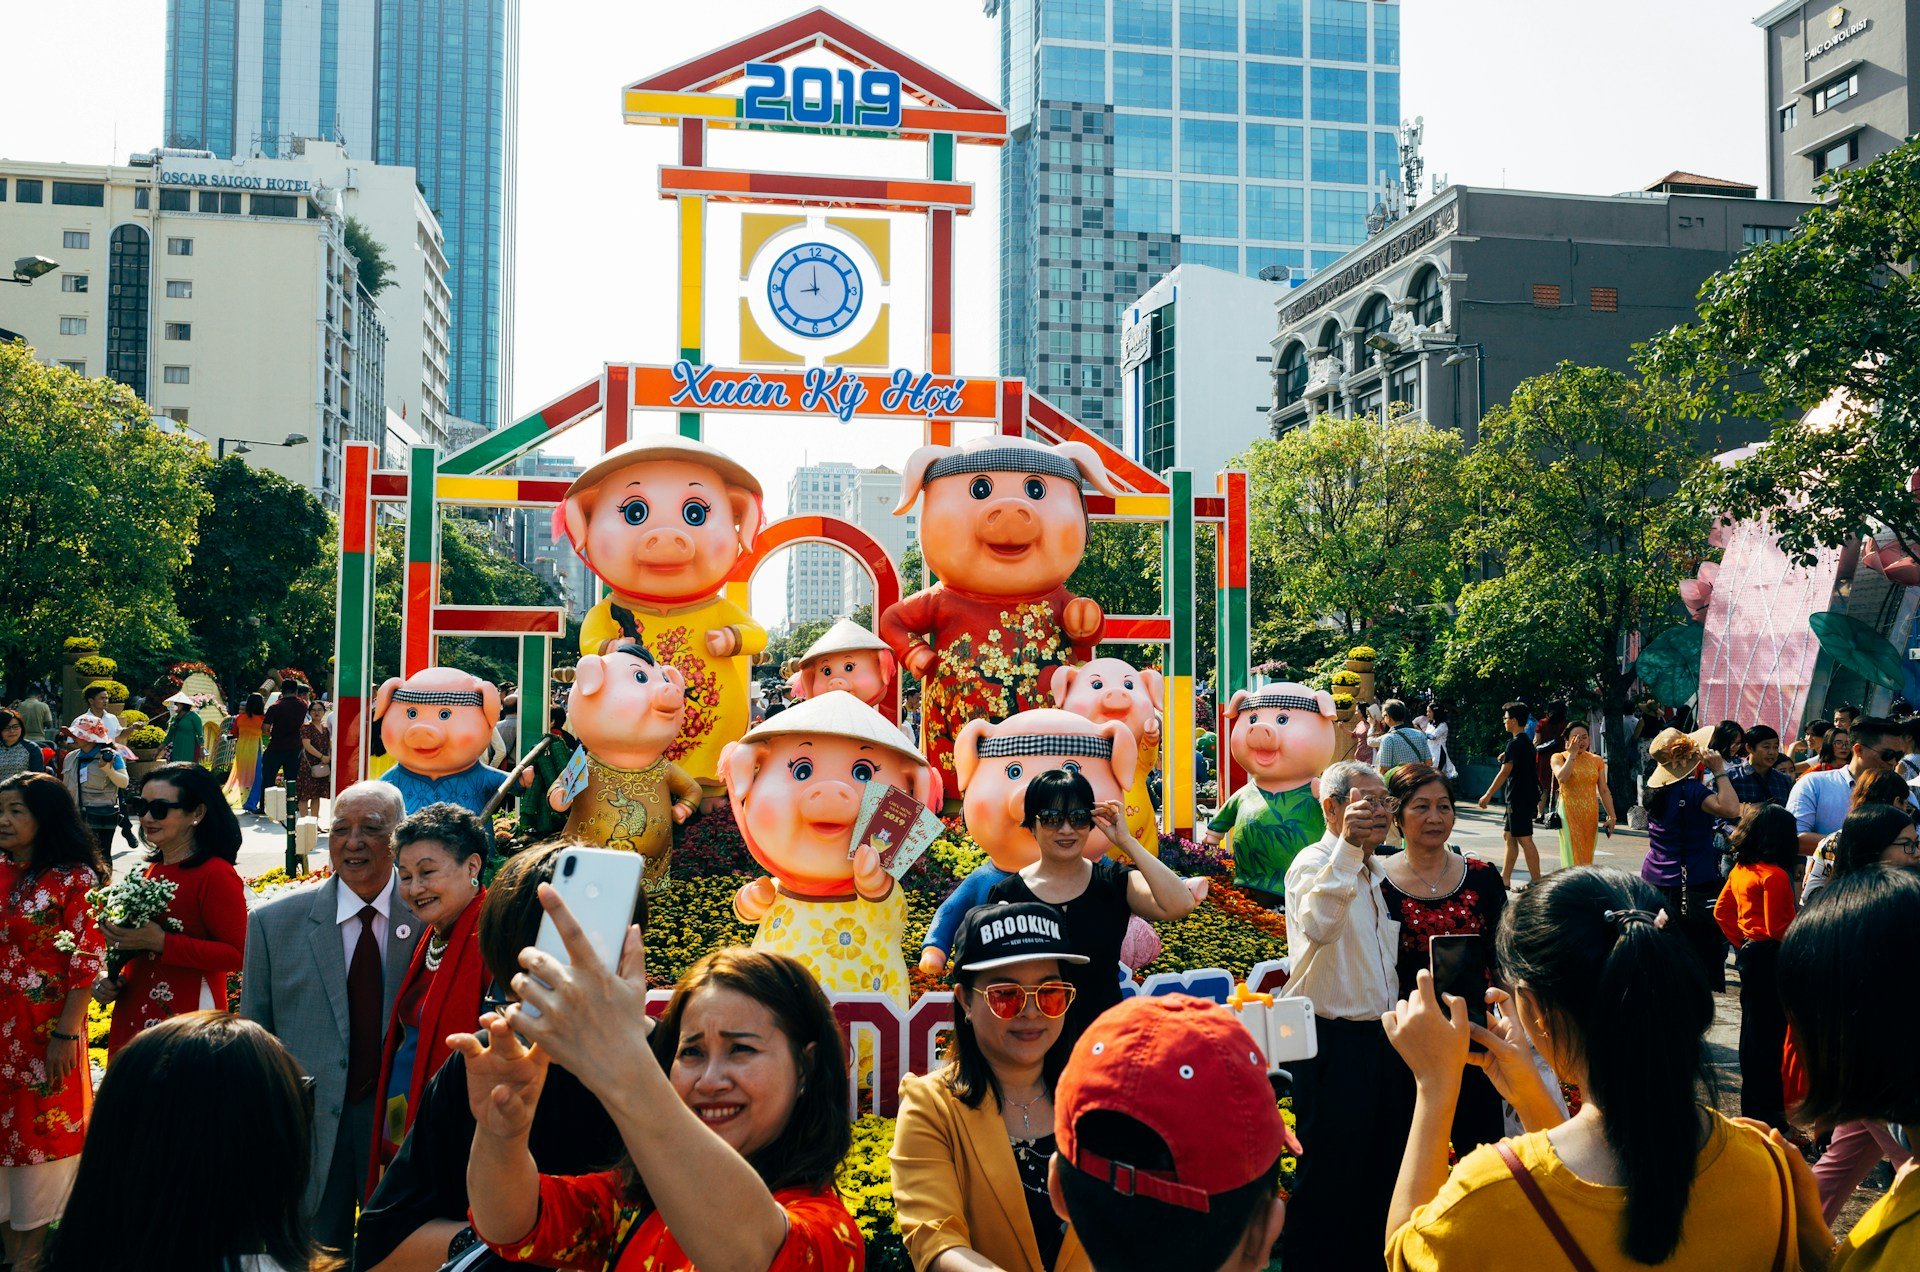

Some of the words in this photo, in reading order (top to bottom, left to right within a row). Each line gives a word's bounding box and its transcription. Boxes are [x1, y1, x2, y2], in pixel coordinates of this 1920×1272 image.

[744, 62, 902, 129] 2019
[162, 172, 207, 186] OSCAR
[211, 174, 261, 189] SAIGON
[266, 178, 311, 192] HOTEL
[809, 248, 821, 257] 12
[1327, 266, 1361, 303] ROYAL
[1361, 246, 1391, 278] CITY
[1391, 219, 1434, 261] HOTEL
[772, 284, 778, 293] 9
[851, 286, 857, 296] 3
[812, 324, 818, 333] 6
[671, 361, 790, 406] Xuân
[801, 366, 867, 424] Kỷ
[881, 367, 966, 419] Hợi
[883, 811, 906, 826] 2019
[980, 914, 1061, 945] BROOKLYN
